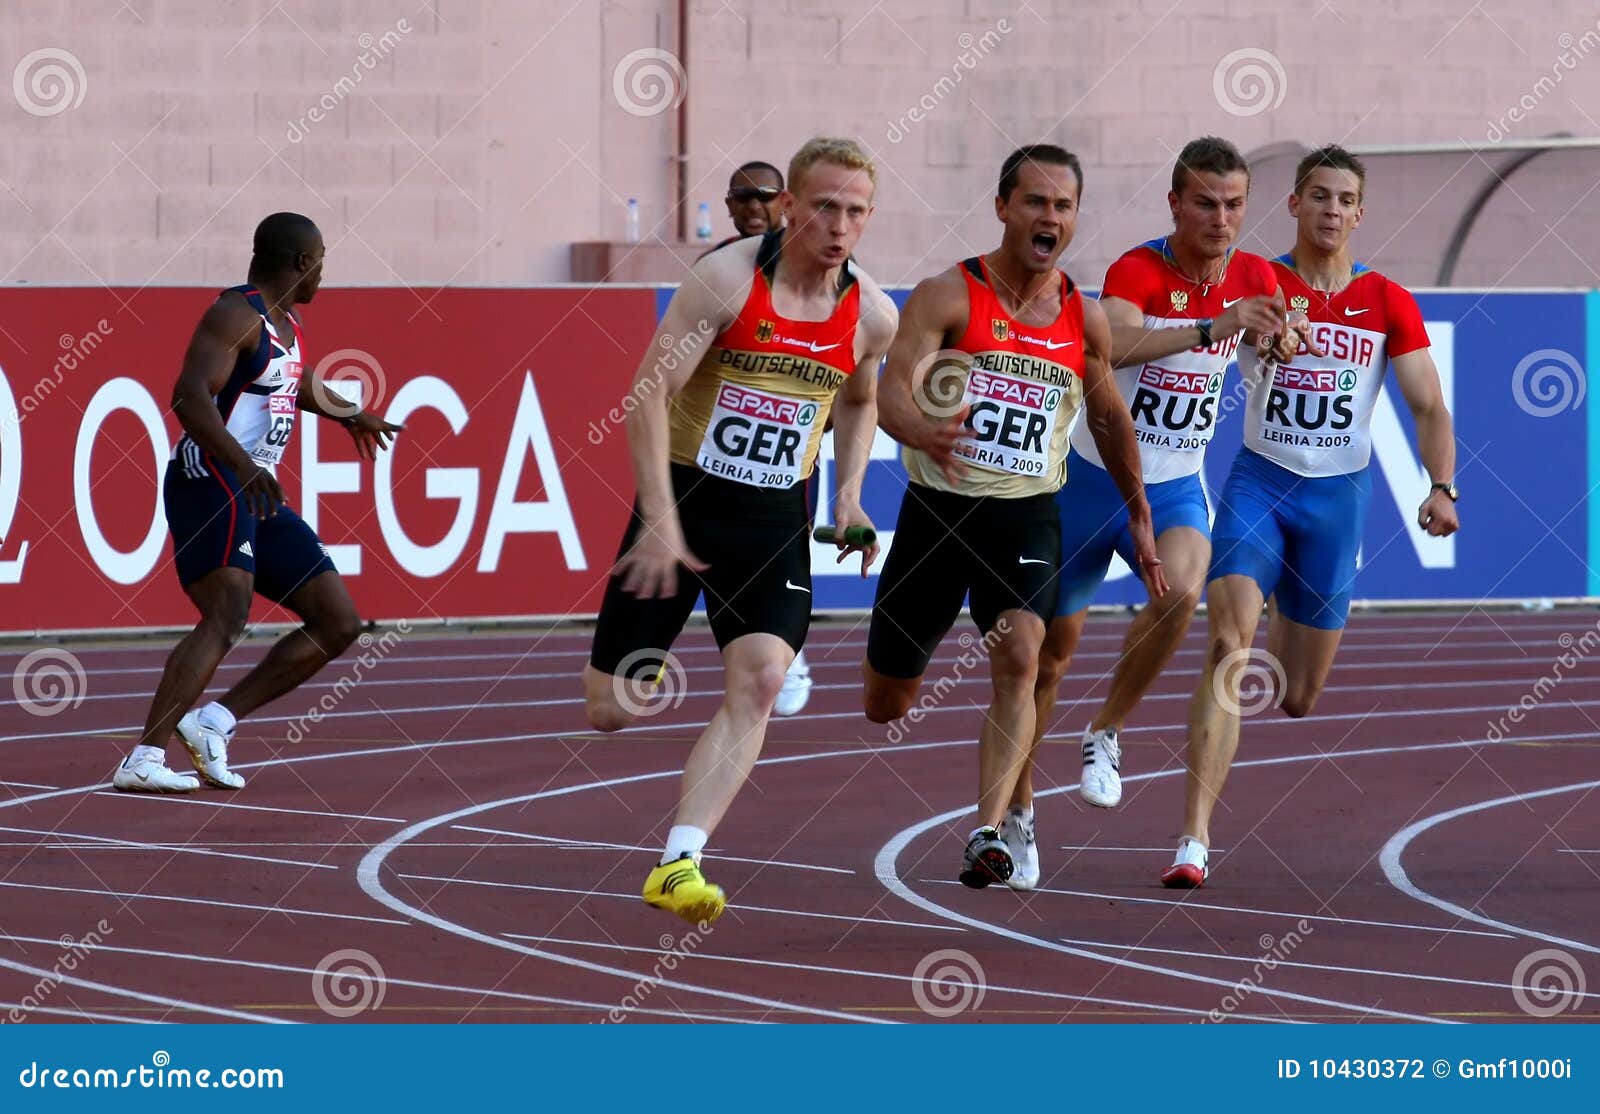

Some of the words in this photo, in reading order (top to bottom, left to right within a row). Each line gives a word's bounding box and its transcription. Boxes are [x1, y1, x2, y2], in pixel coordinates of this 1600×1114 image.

[971, 375, 1043, 405] SPAR
[1142, 367, 1207, 392] SPAR
[1273, 368, 1334, 389] SPAR
[720, 389, 796, 421] SPAR
[1130, 387, 1215, 431] RUS
[1266, 389, 1353, 430] RUS
[713, 416, 800, 467] GER
[964, 401, 1047, 454] GER
[1135, 430, 1170, 446] EIRIA
[1264, 429, 1310, 446] LEIRIA
[1316, 436, 1351, 447] 2009
[73, 369, 588, 585] OEGA
[702, 456, 753, 481] LEIRIA
[759, 472, 794, 487] 2009
[1010, 458, 1043, 473] 2009
